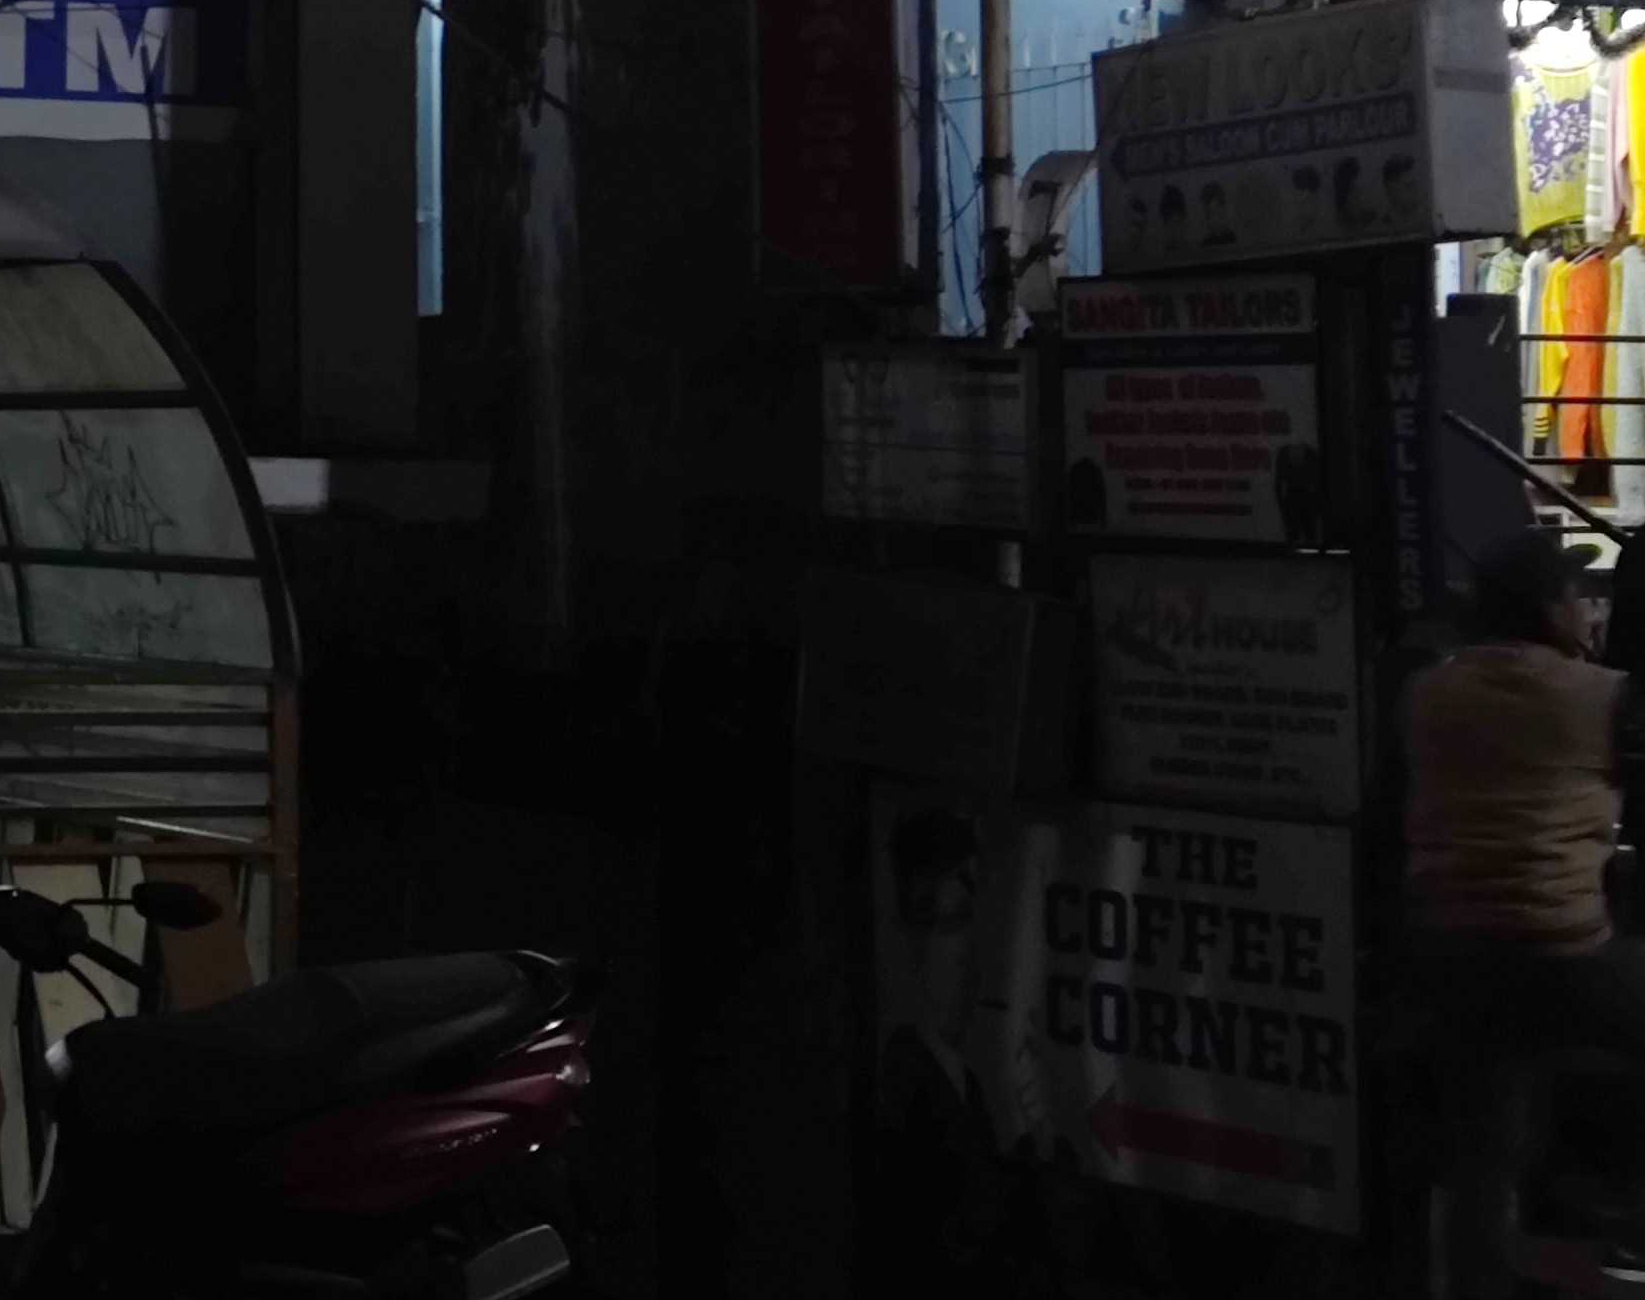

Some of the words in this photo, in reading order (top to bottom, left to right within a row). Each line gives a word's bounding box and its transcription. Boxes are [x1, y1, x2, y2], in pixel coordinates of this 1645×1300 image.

[1385, 300, 1425, 612] JEWELLERS
[1131, 826, 1258, 890] THE
[1045, 881, 1325, 993] COFFEE
[1046, 975, 1349, 1095] CORNER
